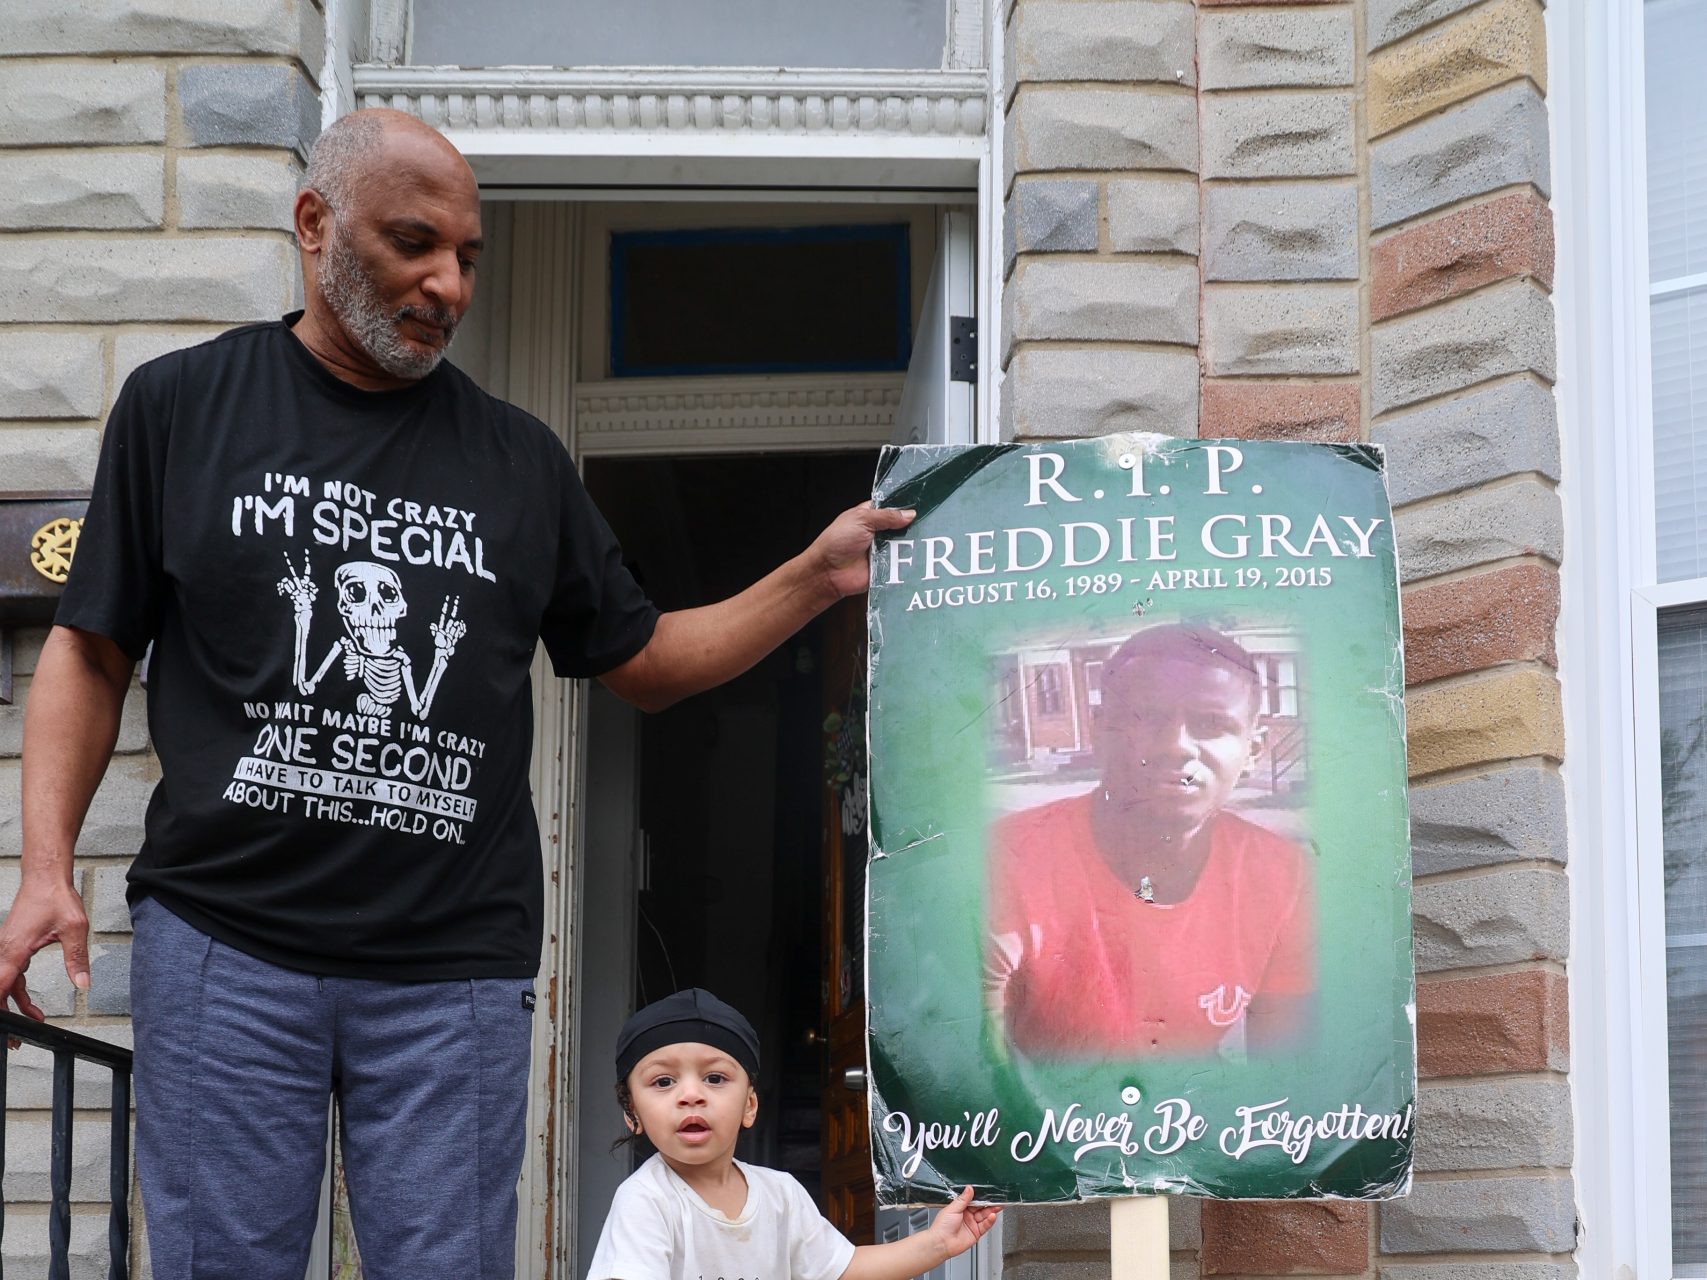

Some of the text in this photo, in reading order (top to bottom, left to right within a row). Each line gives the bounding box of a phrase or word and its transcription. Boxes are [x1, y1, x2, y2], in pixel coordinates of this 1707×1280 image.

[264, 472, 476, 532] I'M NOT CRAZY
[231, 495, 497, 584] I'M SPECIAL
[884, 513, 1385, 586] FREDDIE GRAY
[906, 581, 1018, 612] AUGUST
[1025, 577, 1058, 601] 16,
[1065, 572, 1122, 595] 1989
[1146, 568, 1228, 591] APRIL
[1236, 568, 1268, 591] 19,
[1275, 567, 1332, 588] 2015
[243, 702, 486, 759] NO WAIT MAYBE I'M CRAZY
[253, 723, 472, 791] ONE SECOND
[222, 781, 295, 814] ABOUT
[245, 762, 288, 784] HAVE
[299, 770, 323, 789] TO
[332, 776, 377, 797] TALK
[387, 783, 411, 802] TO
[415, 791, 475, 820] MYSELF
[883, 1096, 1413, 1178] You'll Never Be Forgotten!
